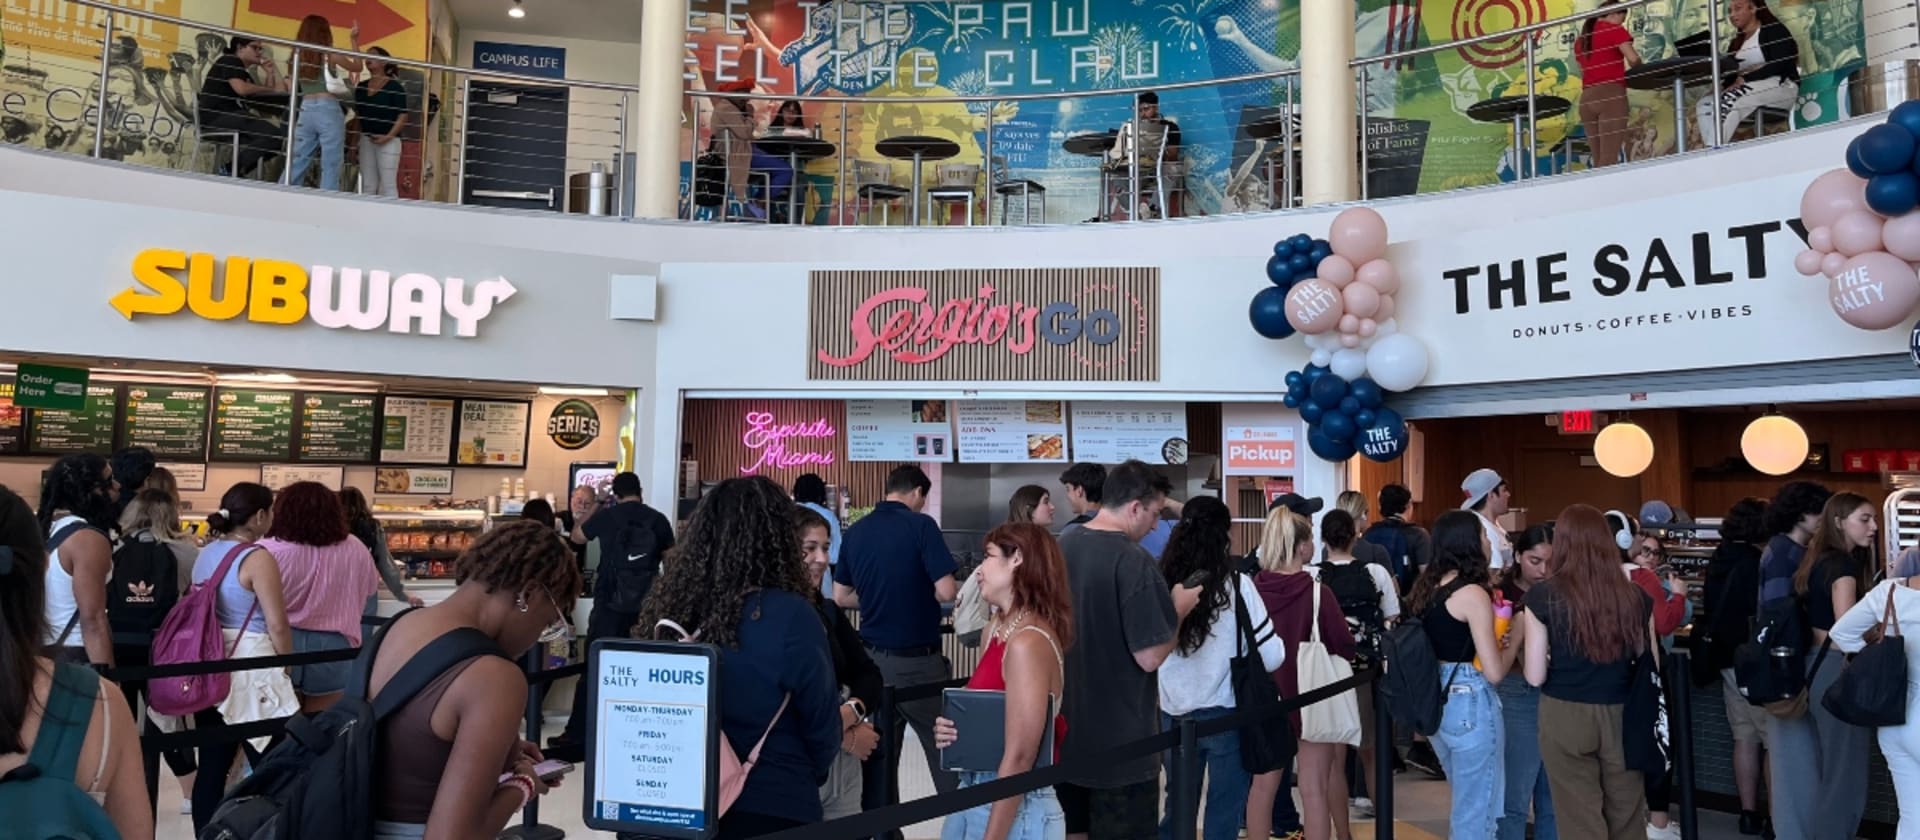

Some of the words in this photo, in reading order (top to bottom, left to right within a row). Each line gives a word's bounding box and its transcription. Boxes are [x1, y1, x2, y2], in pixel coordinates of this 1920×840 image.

[686, 0, 748, 35] EE
[797, 2, 905, 40] THE
[480, 52, 529, 67] CAMPUS
[532, 56, 559, 69] LIFE
[682, 42, 779, 85] EEL
[829, 49, 936, 89] THE
[985, 41, 1159, 87] CLAW
[1384, 135, 1420, 149] Fame
[1443, 251, 1571, 315] THE
[1835, 265, 1871, 292] THE
[108, 247, 518, 338] SUBWAY
[1291, 281, 1322, 306] THE
[1834, 280, 1885, 314] SALTY
[1296, 287, 1337, 324] SALTY
[816, 281, 1039, 367] Sergio's
[20, 373, 54, 385] Order
[19, 385, 46, 397] Here
[463, 412, 486, 422] DEAL
[464, 402, 487, 412] MEAL
[548, 415, 599, 437] SERIES
[1563, 409, 1593, 432] EXIT
[1365, 426, 1392, 442] THE
[1229, 444, 1294, 465] Pickup
[1364, 439, 1398, 455] SALTY
[740, 443, 835, 473] Miami
[603, 675, 640, 688] SALTY
[610, 664, 633, 677] THE
[648, 667, 706, 686] HOURS
[638, 730, 668, 739] FRIDAY
[631, 754, 674, 765] SATURDAY
[635, 778, 668, 789] SUNDAY
